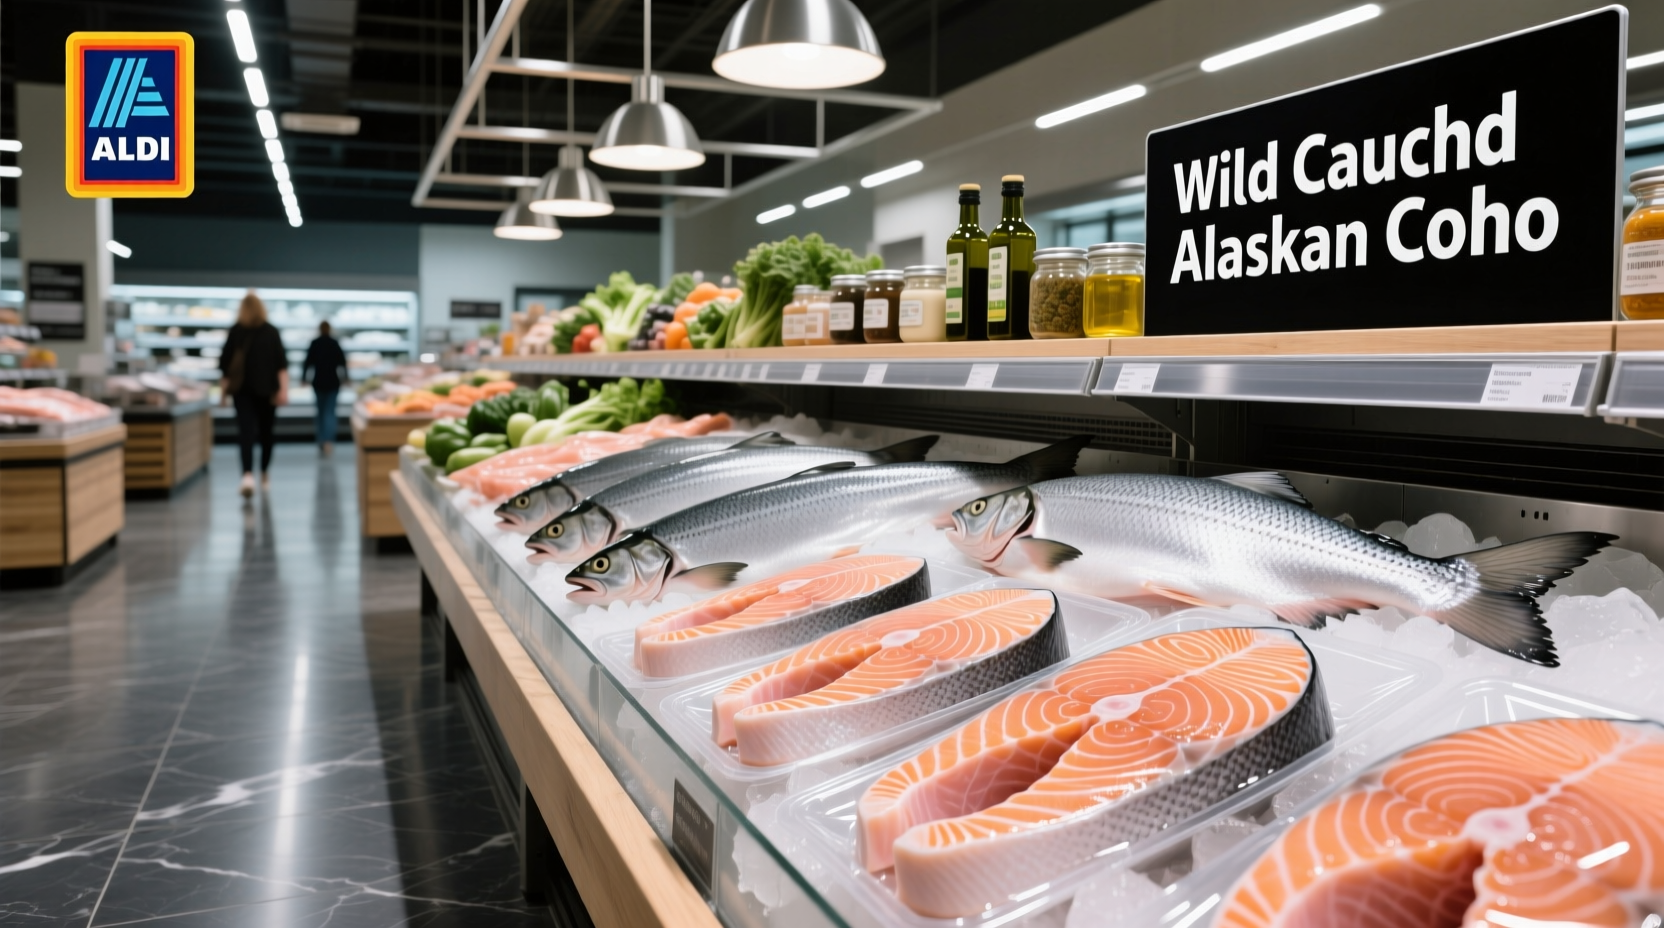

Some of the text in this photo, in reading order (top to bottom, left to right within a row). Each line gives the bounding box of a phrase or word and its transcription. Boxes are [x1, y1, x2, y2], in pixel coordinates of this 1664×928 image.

[1173, 89, 1517, 214] Wild Cauchd
[1169, 184, 1560, 284] Alaskan Coho
